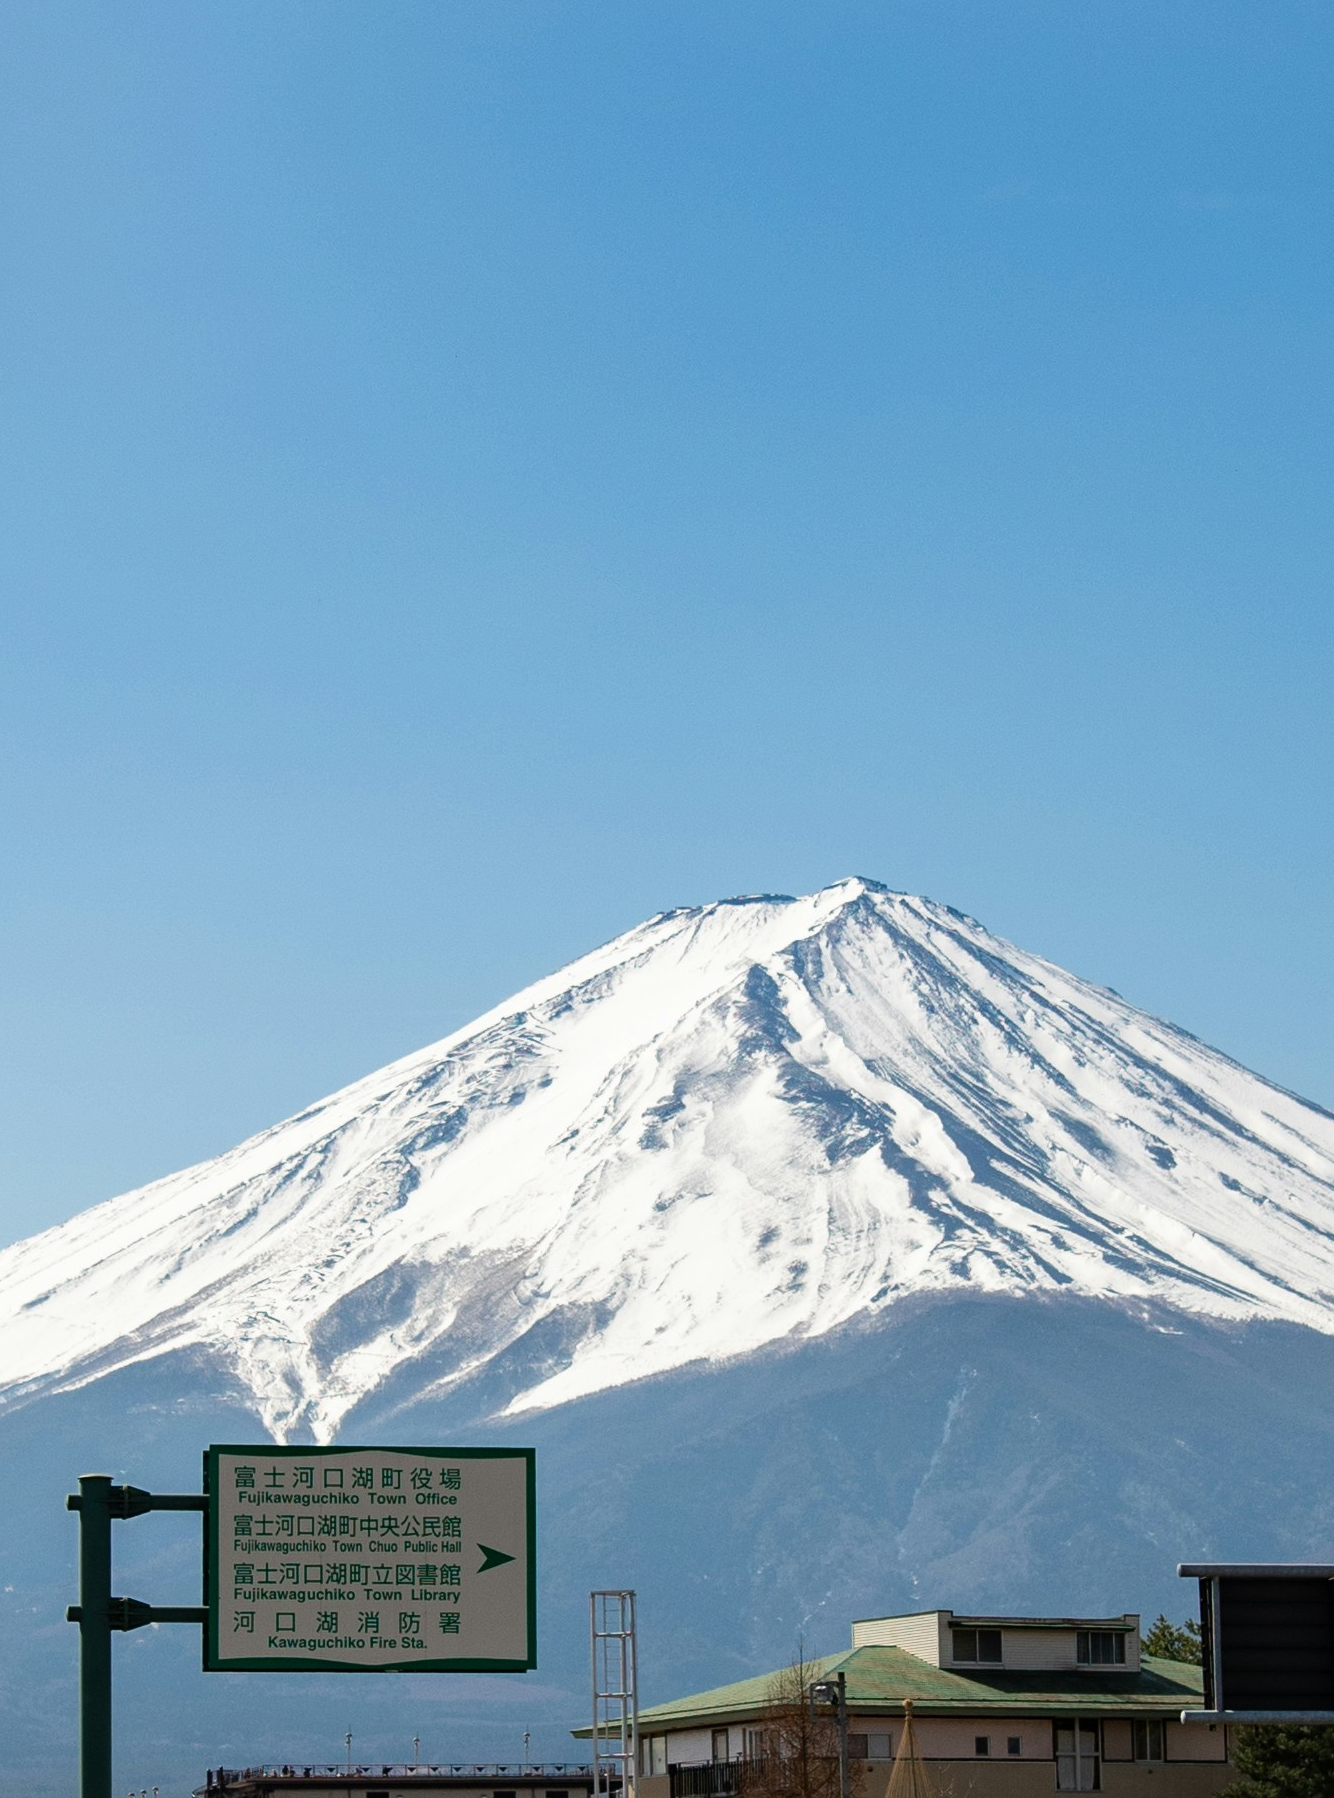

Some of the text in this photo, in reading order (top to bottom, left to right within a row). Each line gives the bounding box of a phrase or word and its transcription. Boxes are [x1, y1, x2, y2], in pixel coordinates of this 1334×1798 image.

[233, 1465, 462, 1491] 富士河口湖町役場
[238, 1491, 457, 1507] Fujikawaguchiko Town Office
[233, 1514, 462, 1539] 富士河口湖町中央公民館
[233, 1539, 462, 1555] Fujikawaguchiko Town Chuo Public Hall
[233, 1562, 462, 1585] 富士河口湖町立図書館
[233, 1588, 461, 1604] Fujikawaguchiko Town Library
[233, 1611, 462, 1635] 河口湖消防署
[268, 1635, 428, 1651] Kawaguchiko Fire Sta.
